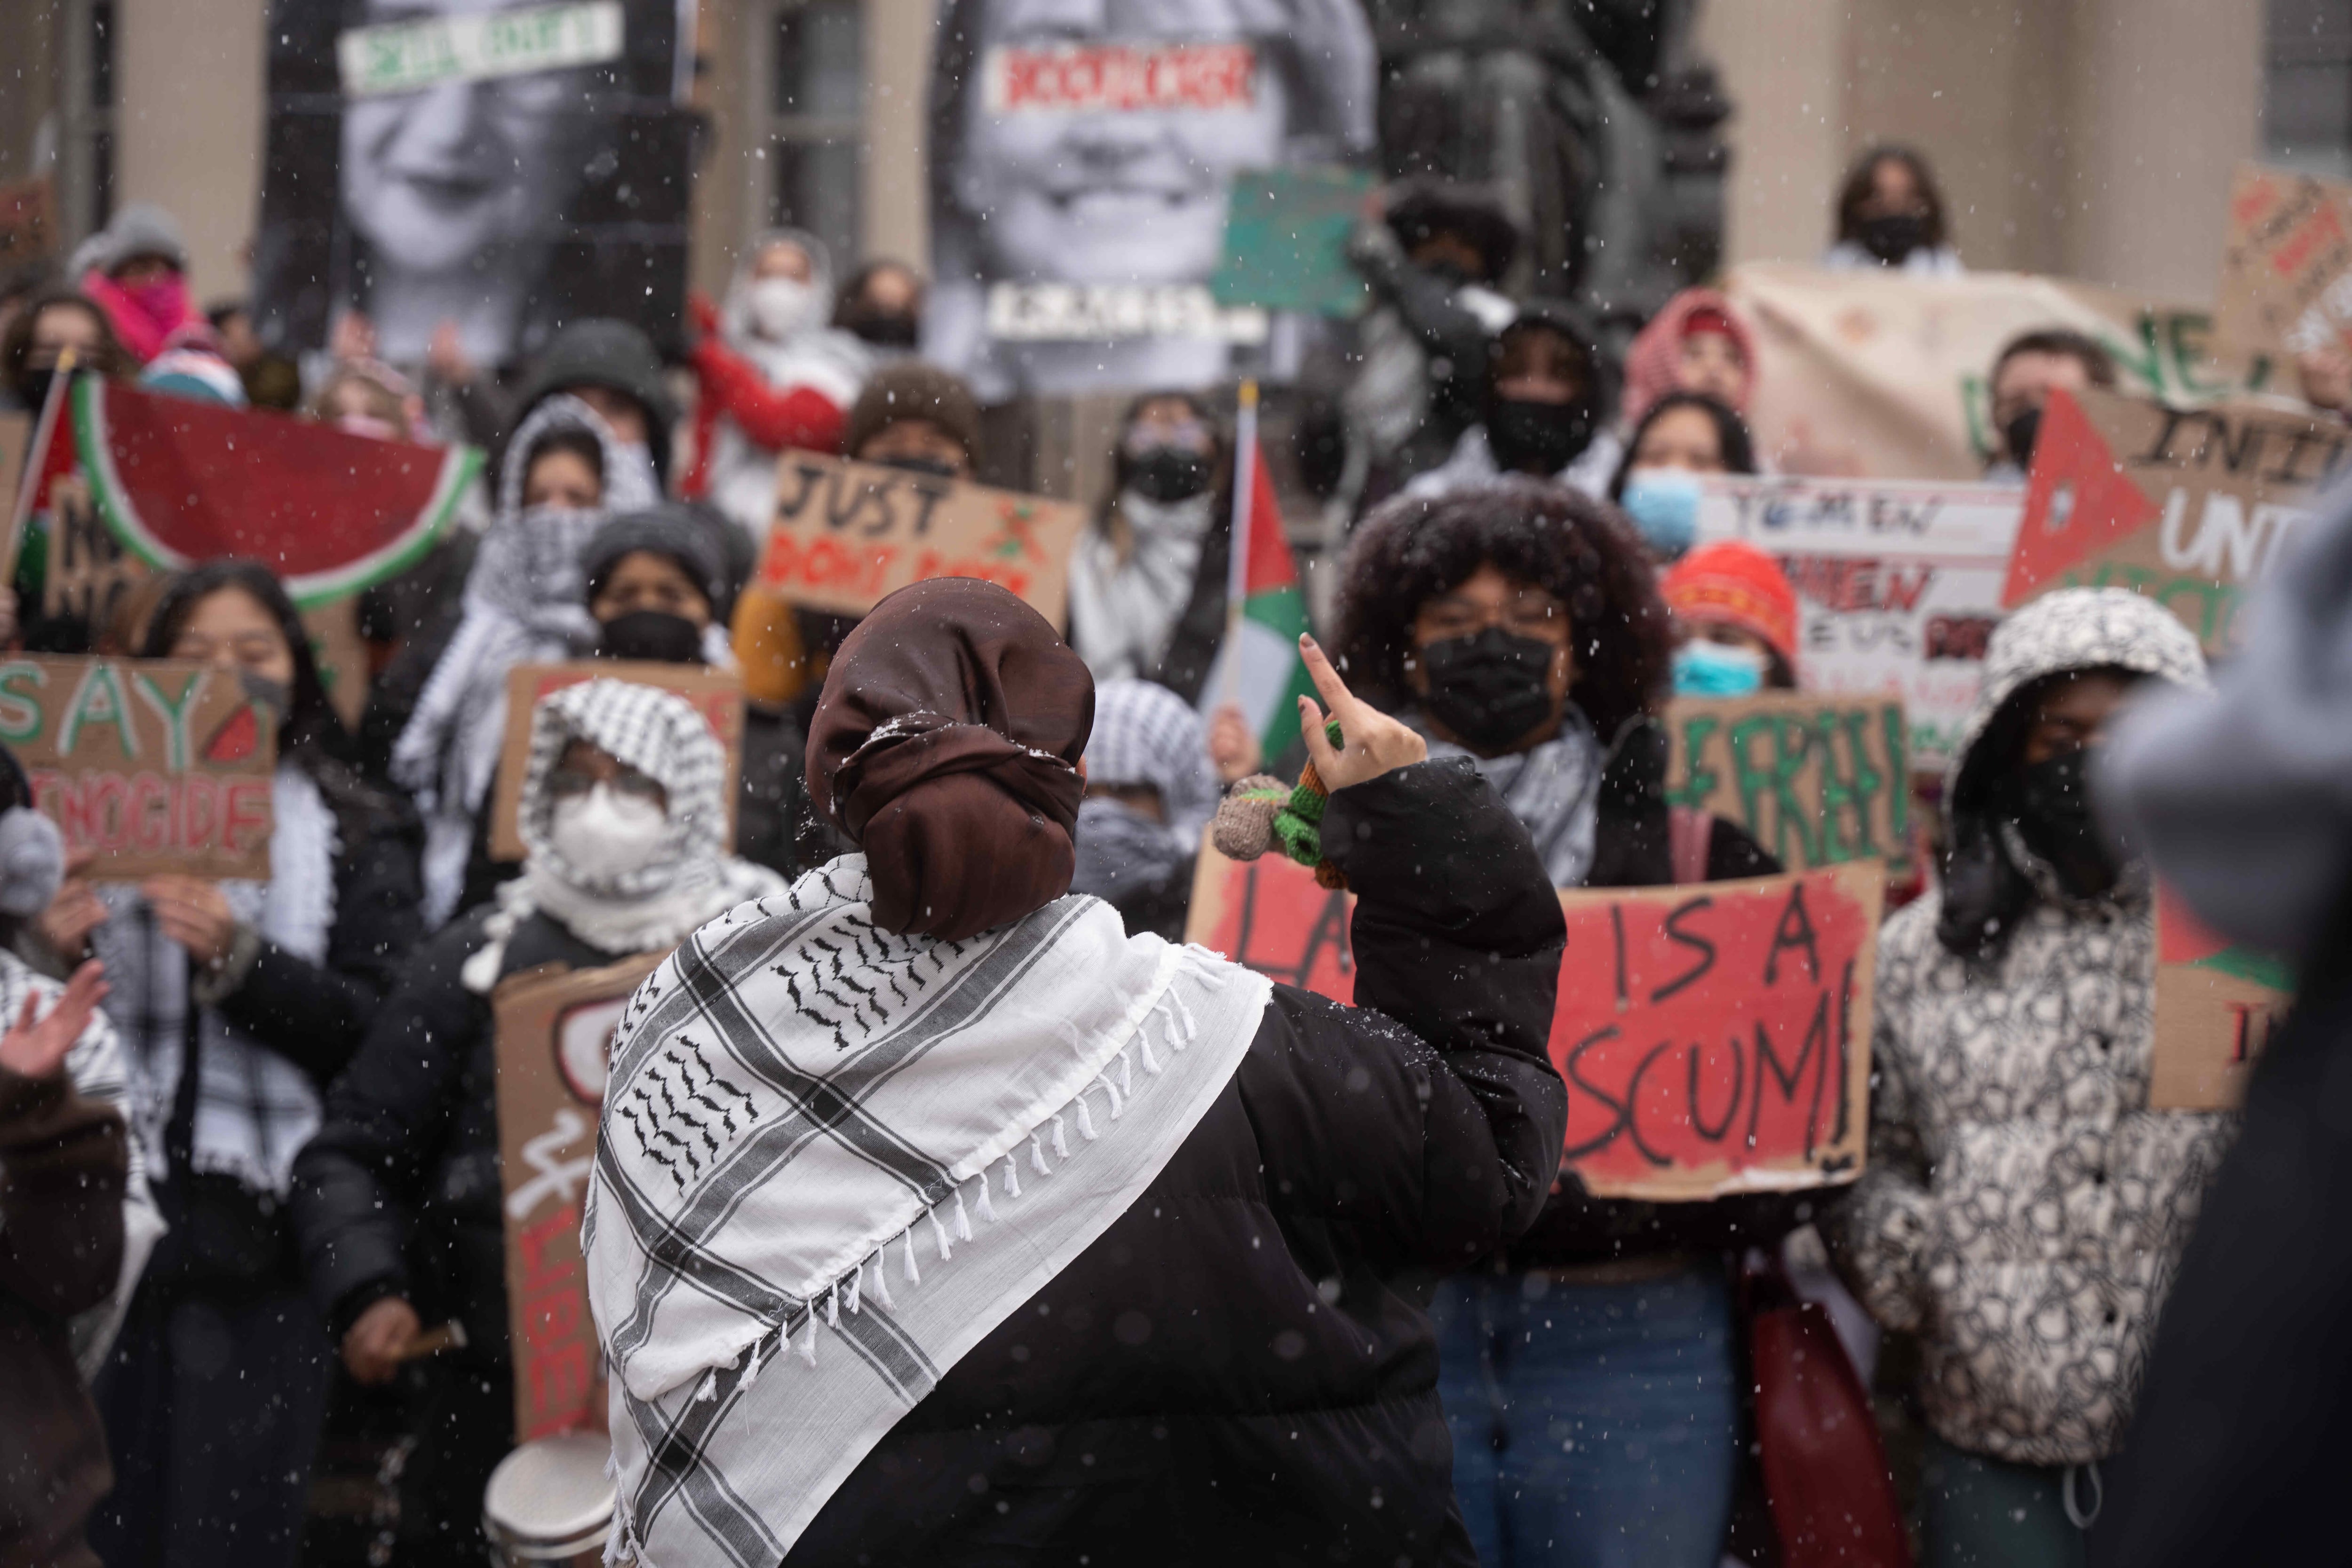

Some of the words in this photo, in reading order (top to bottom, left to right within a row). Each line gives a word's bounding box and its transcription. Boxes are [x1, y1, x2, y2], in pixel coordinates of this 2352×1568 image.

[781, 463, 956, 542] JUST
[0, 660, 213, 772] SAY
[1610, 895, 1718, 1011] IS
[1763, 881, 1820, 986] A
